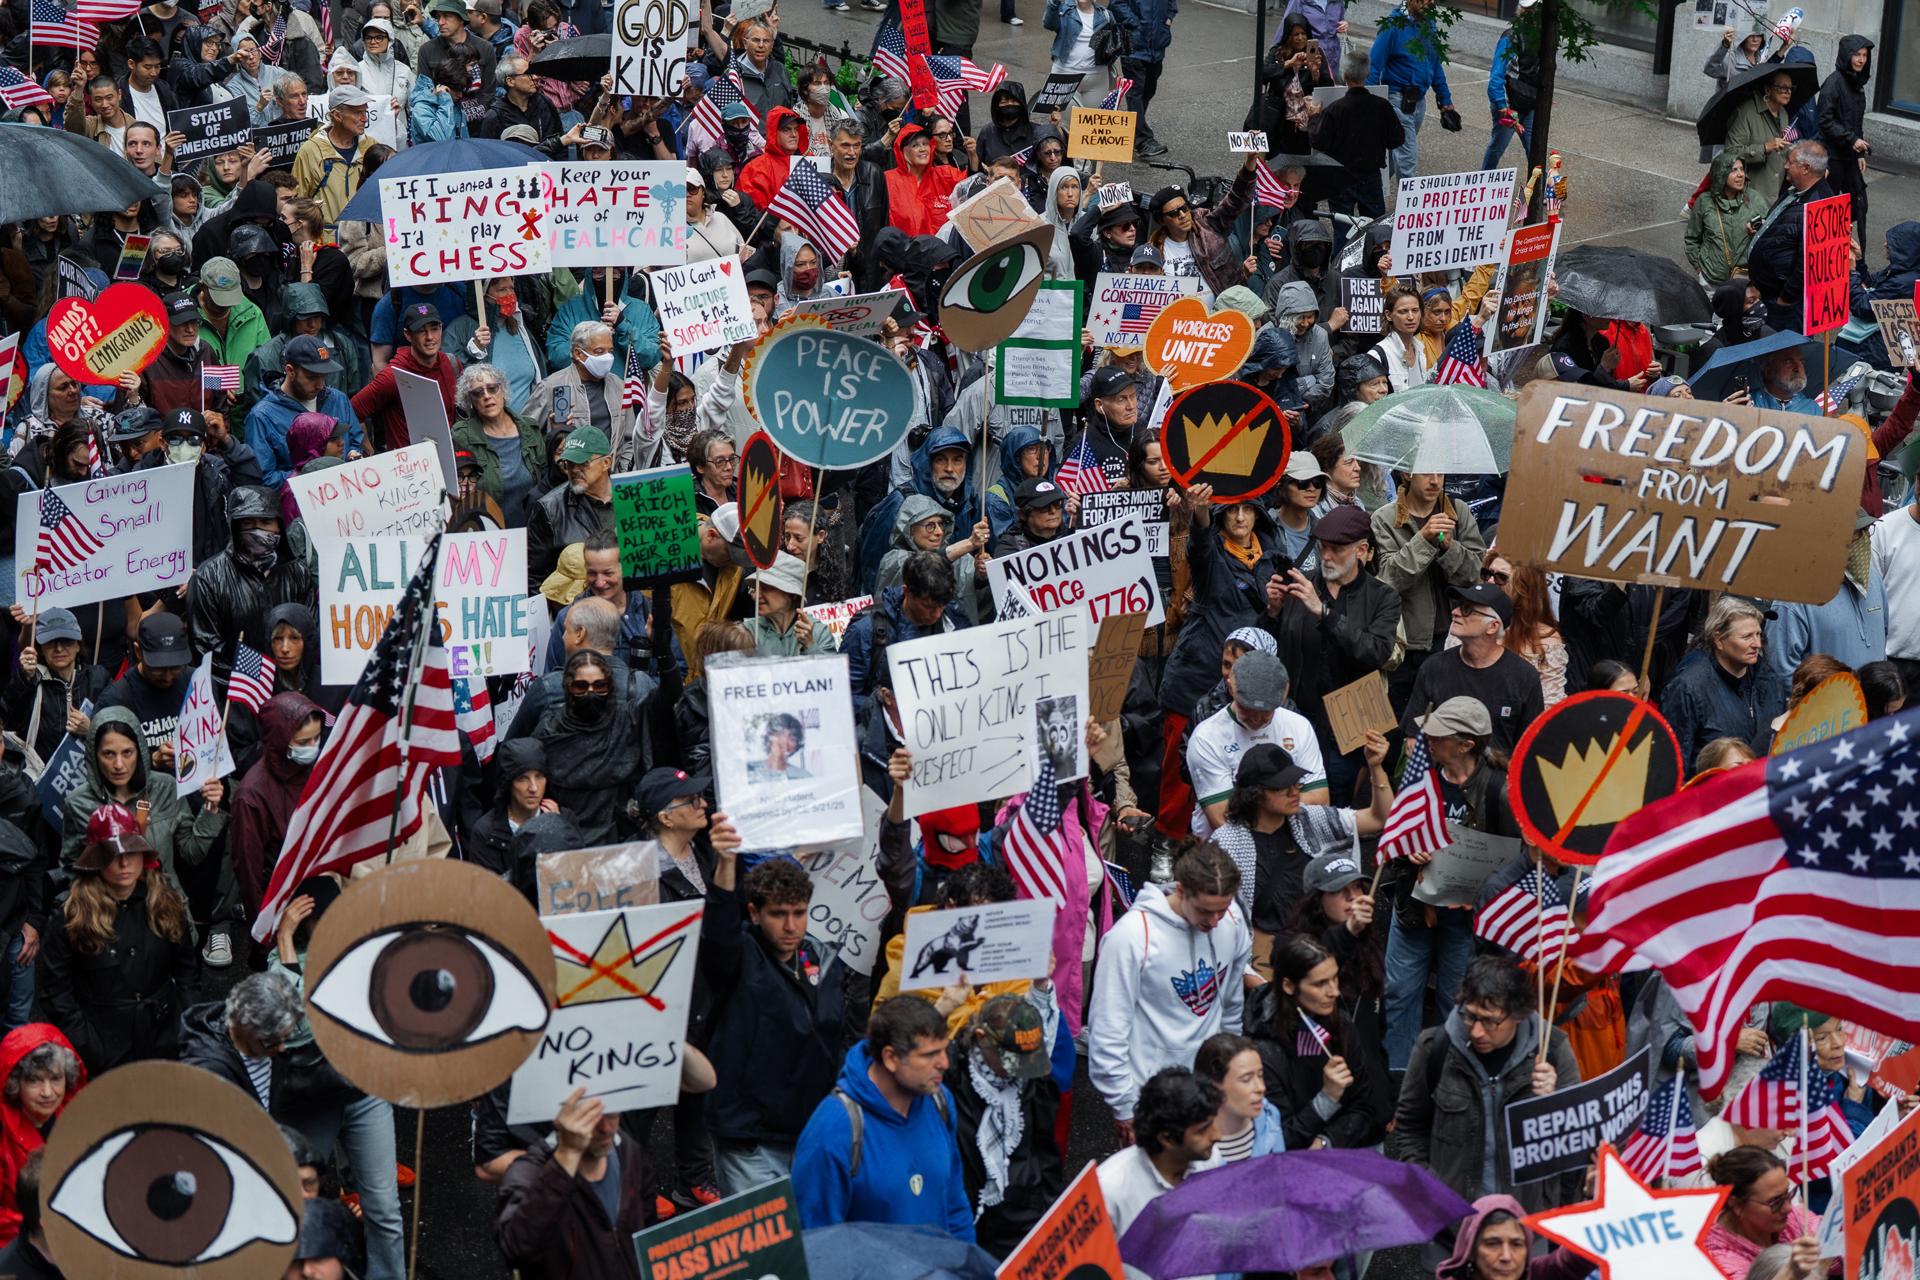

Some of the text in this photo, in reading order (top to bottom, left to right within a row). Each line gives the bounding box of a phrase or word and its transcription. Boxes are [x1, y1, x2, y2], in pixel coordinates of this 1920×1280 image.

[617, 0, 689, 46] GOD
[643, 37, 665, 59] IS
[615, 56, 686, 96] KING
[190, 107, 232, 127] STATE
[205, 123, 221, 137] OF
[174, 128, 251, 157] EMERGENCY
[267, 127, 312, 147] PAIR THIS
[1081, 135, 1129, 146] REMOVE
[1230, 133, 1242, 149] NO
[396, 177, 508, 200] If I wanted a
[561, 167, 651, 189] Keep your
[1401, 171, 1515, 192] WE SHOULD NOT HAVE
[410, 191, 521, 224] KING
[551, 186, 650, 208] HATE
[1406, 187, 1510, 209] TO PROTECT THE
[554, 209, 645, 228] out of my
[1397, 204, 1507, 231] CONSTITUTION
[1807, 203, 1851, 246] RESTORE
[401, 223, 502, 249] I'd play
[1407, 225, 1485, 248] FROM THE
[409, 242, 527, 277] CHESS
[1406, 243, 1494, 270] PRESIDENT!
[1514, 247, 1528, 255] Crisis
[1808, 242, 1849, 287] RULE OF
[60, 260, 76, 281] OUR
[657, 270, 686, 295] YOU
[1111, 277, 1180, 291] WE HAVE A
[844, 292, 898, 307] HUMAN
[1101, 288, 1184, 305] CONSTITUTION
[1350, 279, 1376, 296] RISE
[1503, 291, 1541, 306] No Dictators
[663, 286, 729, 319] the CULTURE
[1350, 298, 1384, 314] AGAIN
[1507, 305, 1534, 318] No Kings
[1811, 283, 1848, 327] LAW
[1873, 303, 1917, 320] FASCIST
[48, 301, 87, 351] HANDS
[673, 315, 756, 347] SUPPORT the PEOPLE
[1172, 319, 1235, 343] WORKERS
[1350, 315, 1382, 332] CRUEL
[64, 315, 103, 361] OFF!
[88, 315, 153, 374] IMMIGRANTS
[1104, 332, 1139, 344] NOT A
[797, 335, 892, 382] PEACE
[1161, 338, 1223, 368] UNITE
[823, 371, 861, 400] IS
[774, 390, 889, 447] POWER
[394, 451, 408, 462] TO
[1536, 395, 1849, 493] FREEDOM
[392, 458, 433, 476] TRUMP!
[86, 479, 147, 504] Giving
[307, 466, 381, 508] NO NO
[645, 477, 667, 496] THE
[1082, 489, 1164, 508] IF THERE'S MONEY
[1637, 467, 1729, 511] FROM
[633, 491, 687, 513] RICH
[95, 502, 160, 538] Small
[337, 509, 364, 537] NO
[621, 509, 691, 533] BEFORE WE
[1082, 508, 1106, 526] FOR
[623, 523, 698, 549] ALL ARE IN
[1143, 526, 1161, 537] NEY
[1547, 500, 1781, 586] WANT
[337, 537, 508, 592] ALL MY
[622, 544, 663, 564] THEIR
[632, 554, 701, 577] MUSEUM
[1002, 520, 1142, 587] NO KINGS
[26, 549, 186, 598] Dictator Energy
[1029, 579, 1085, 613] ince
[330, 593, 528, 650] HOMS HATE
[897, 614, 1078, 700] THIS IS THE
[724, 678, 833, 700] FREE DYLAN!
[914, 673, 1052, 750] ONLY KING I
[911, 745, 977, 791] RESPECT
[809, 904, 868, 957] OOKS
[539, 1026, 592, 1060] NO
[568, 1041, 677, 1085] KINGS
[1522, 1072, 1643, 1142] REPAIR THIS
[1511, 1089, 1649, 1169] BROKEN WORLD
[1856, 1129, 1917, 1198] IMMIGRANTS
[1852, 1175, 1896, 1225] ARE NEW
[1585, 1209, 1683, 1254] UNITE
[651, 1245, 710, 1280] PASS
[710, 1214, 794, 1267] NY4ALL
